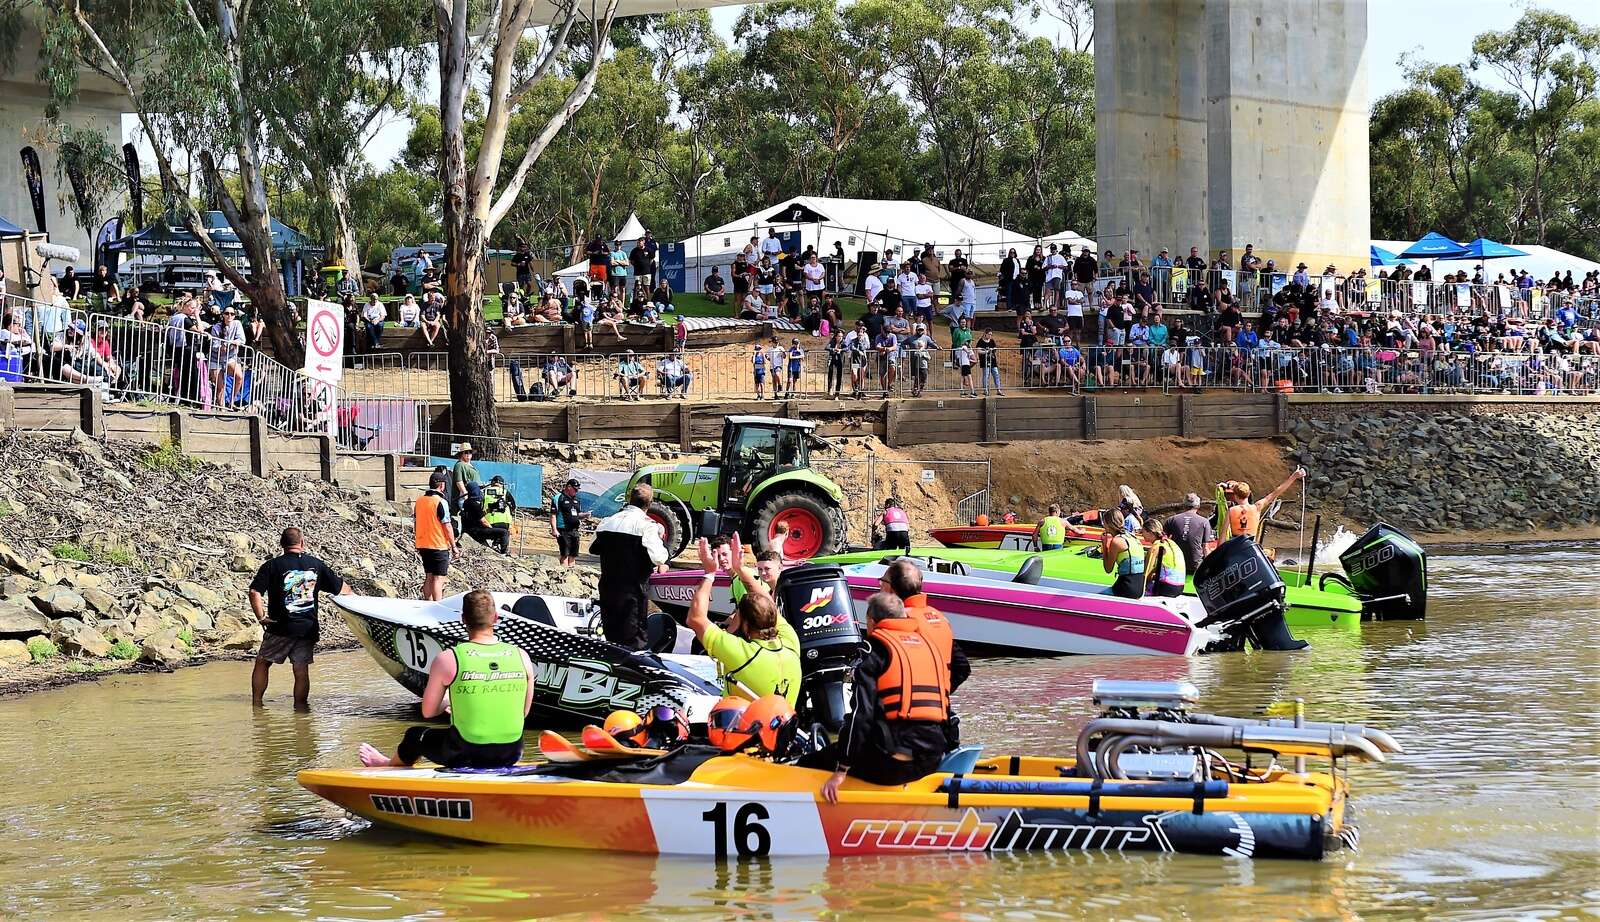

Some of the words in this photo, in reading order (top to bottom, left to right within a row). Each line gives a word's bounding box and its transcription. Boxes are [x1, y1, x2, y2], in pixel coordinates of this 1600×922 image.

[221, 241, 243, 249] TRAILERS
[1013, 537, 1032, 552] 17
[1350, 544, 1395, 577] 300
[1207, 556, 1259, 601] 300
[405, 628, 428, 669] 15
[455, 684, 477, 695] SKI
[482, 682, 525, 694] RACING
[702, 802, 772, 858] 16
